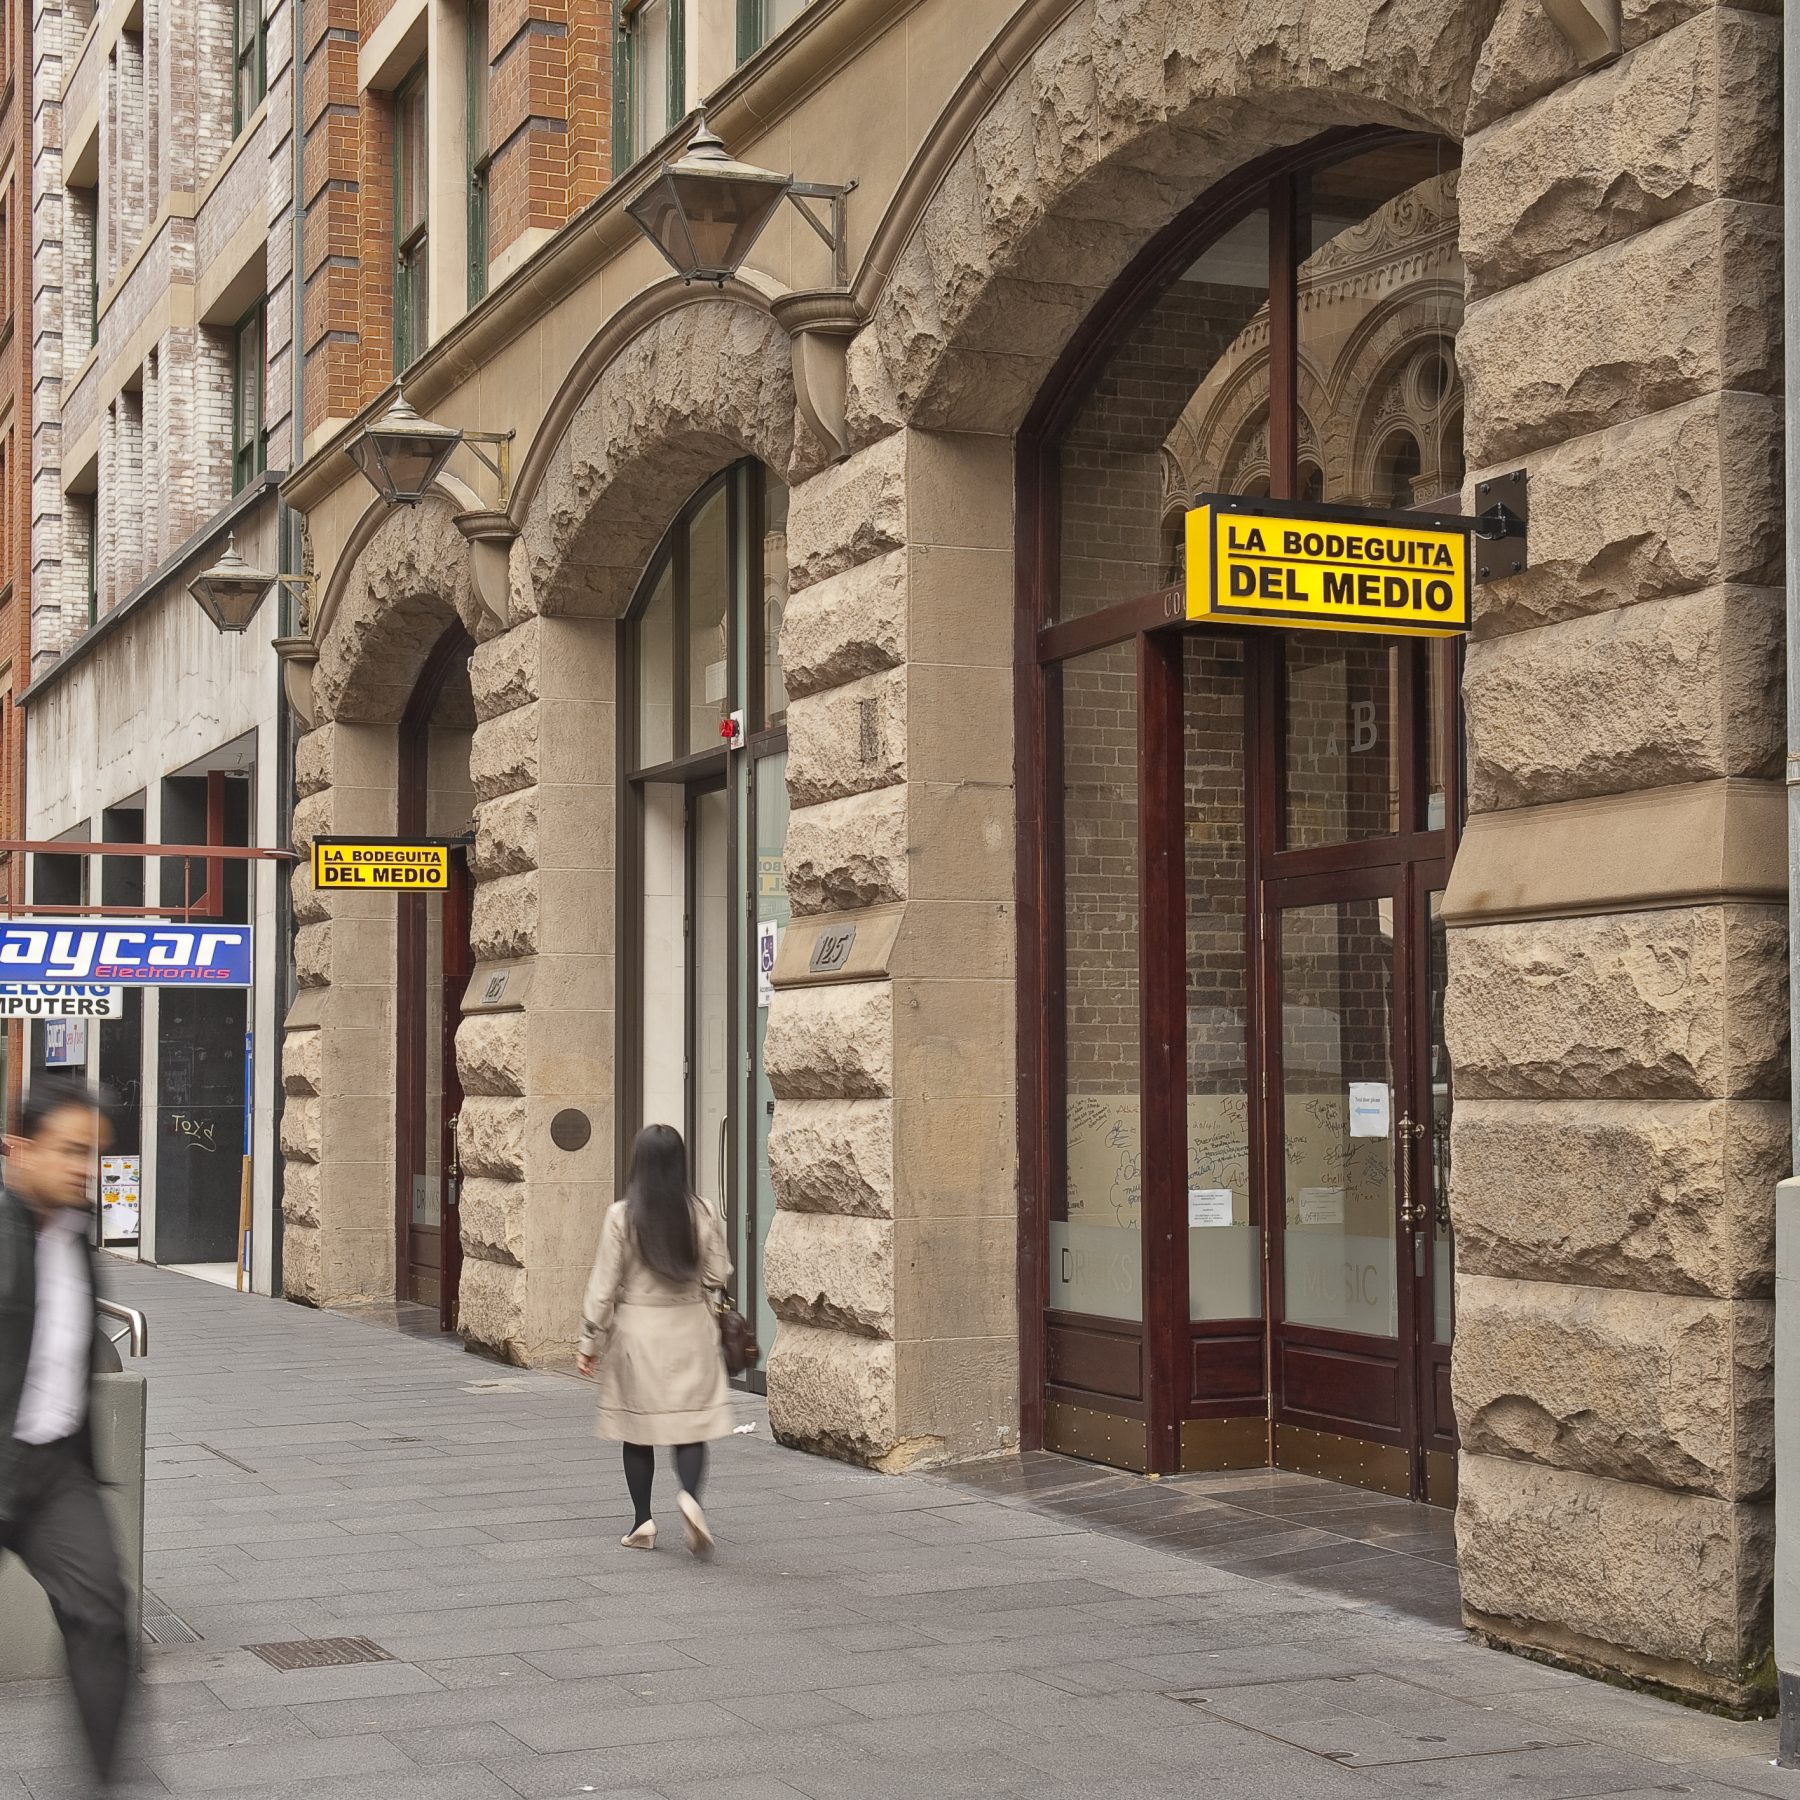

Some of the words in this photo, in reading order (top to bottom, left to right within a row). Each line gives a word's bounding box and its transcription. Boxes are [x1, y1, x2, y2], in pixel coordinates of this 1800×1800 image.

[1228, 526, 1266, 553] LA
[1283, 530, 1454, 567] BODEGUITA
[1229, 564, 1309, 602] DEL
[1322, 571, 1454, 612] MEDIO
[1163, 591, 1186, 618] CO
[324, 850, 344, 862] LA
[352, 850, 441, 863] BODEGUITA
[325, 867, 366, 882] DEL
[373, 867, 441, 883] MEDIO
[816, 934, 849, 965] 125
[95, 965, 231, 979] Electronics
[1061, 1247, 1132, 1293] DRKS
